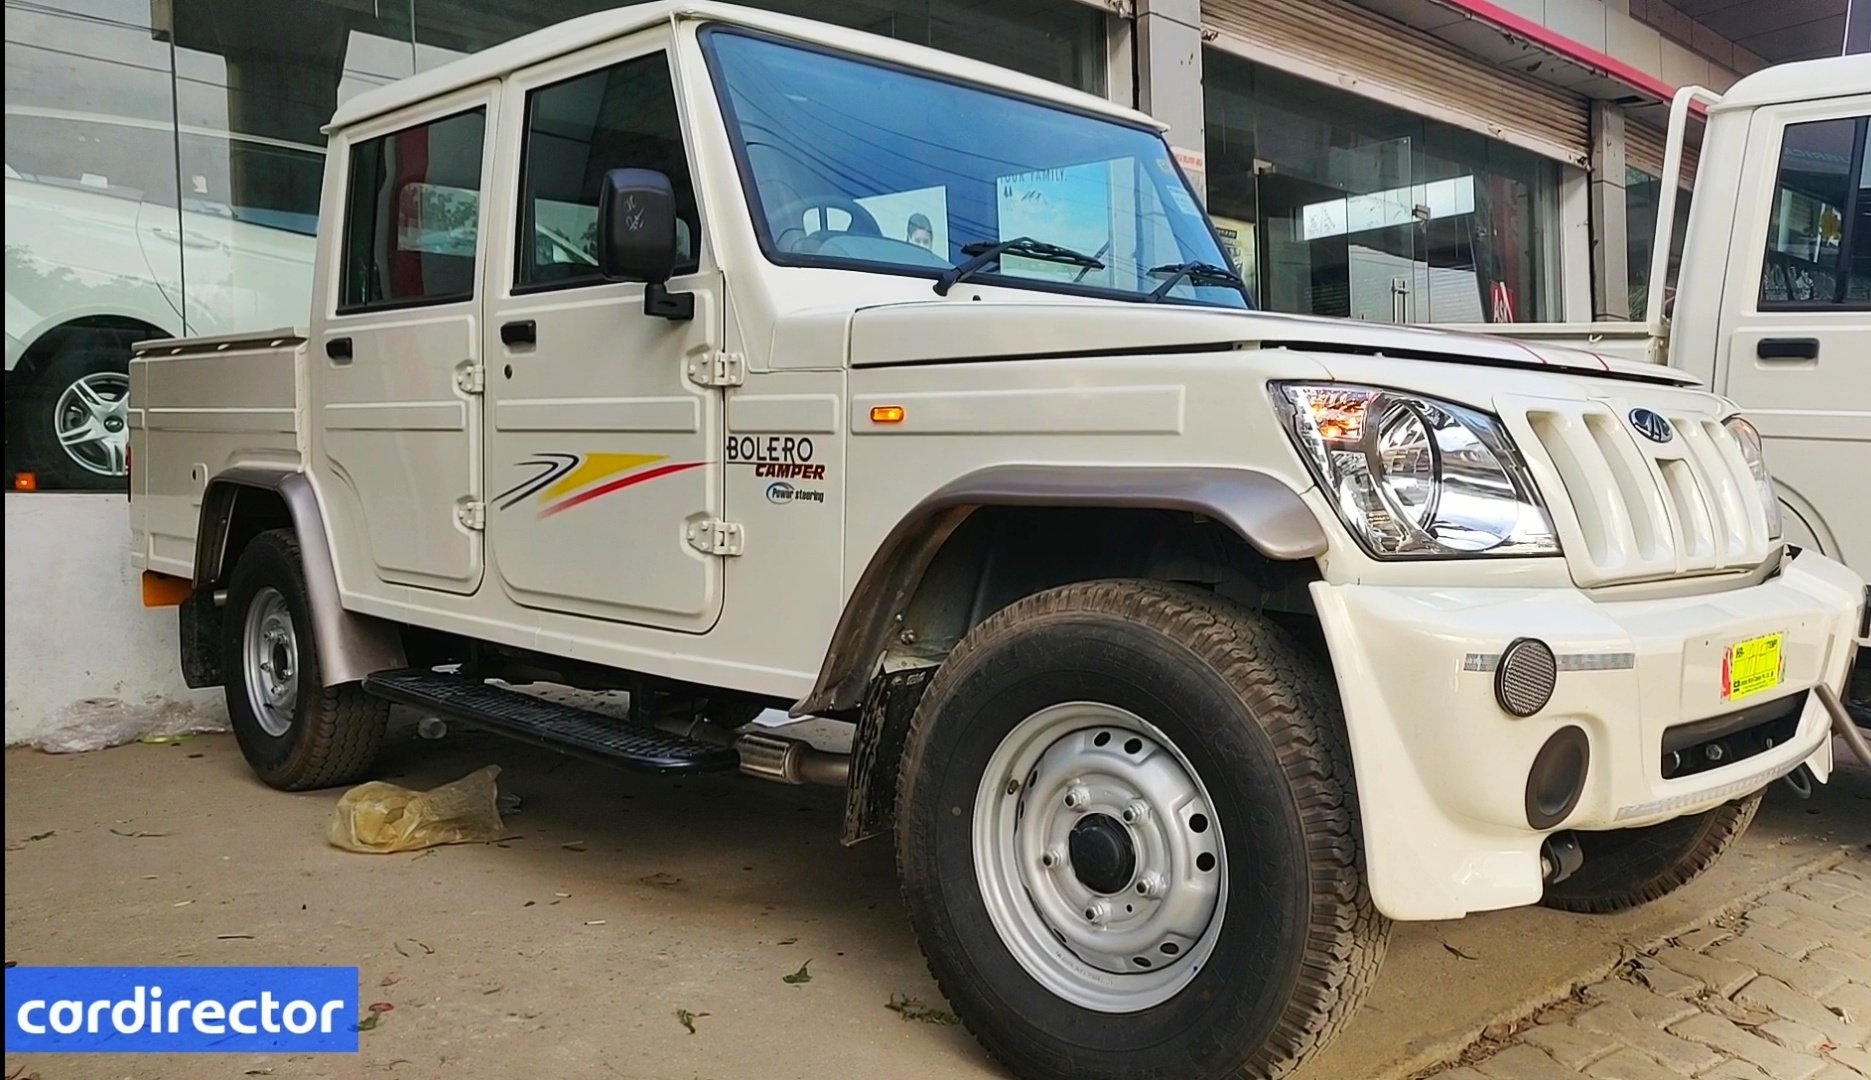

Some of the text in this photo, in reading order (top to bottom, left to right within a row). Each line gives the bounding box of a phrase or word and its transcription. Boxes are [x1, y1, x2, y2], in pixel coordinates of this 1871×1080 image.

[727, 436, 813, 463] BOLERO
[755, 464, 825, 480] CAMPER
[771, 487, 824, 503] Power steering
